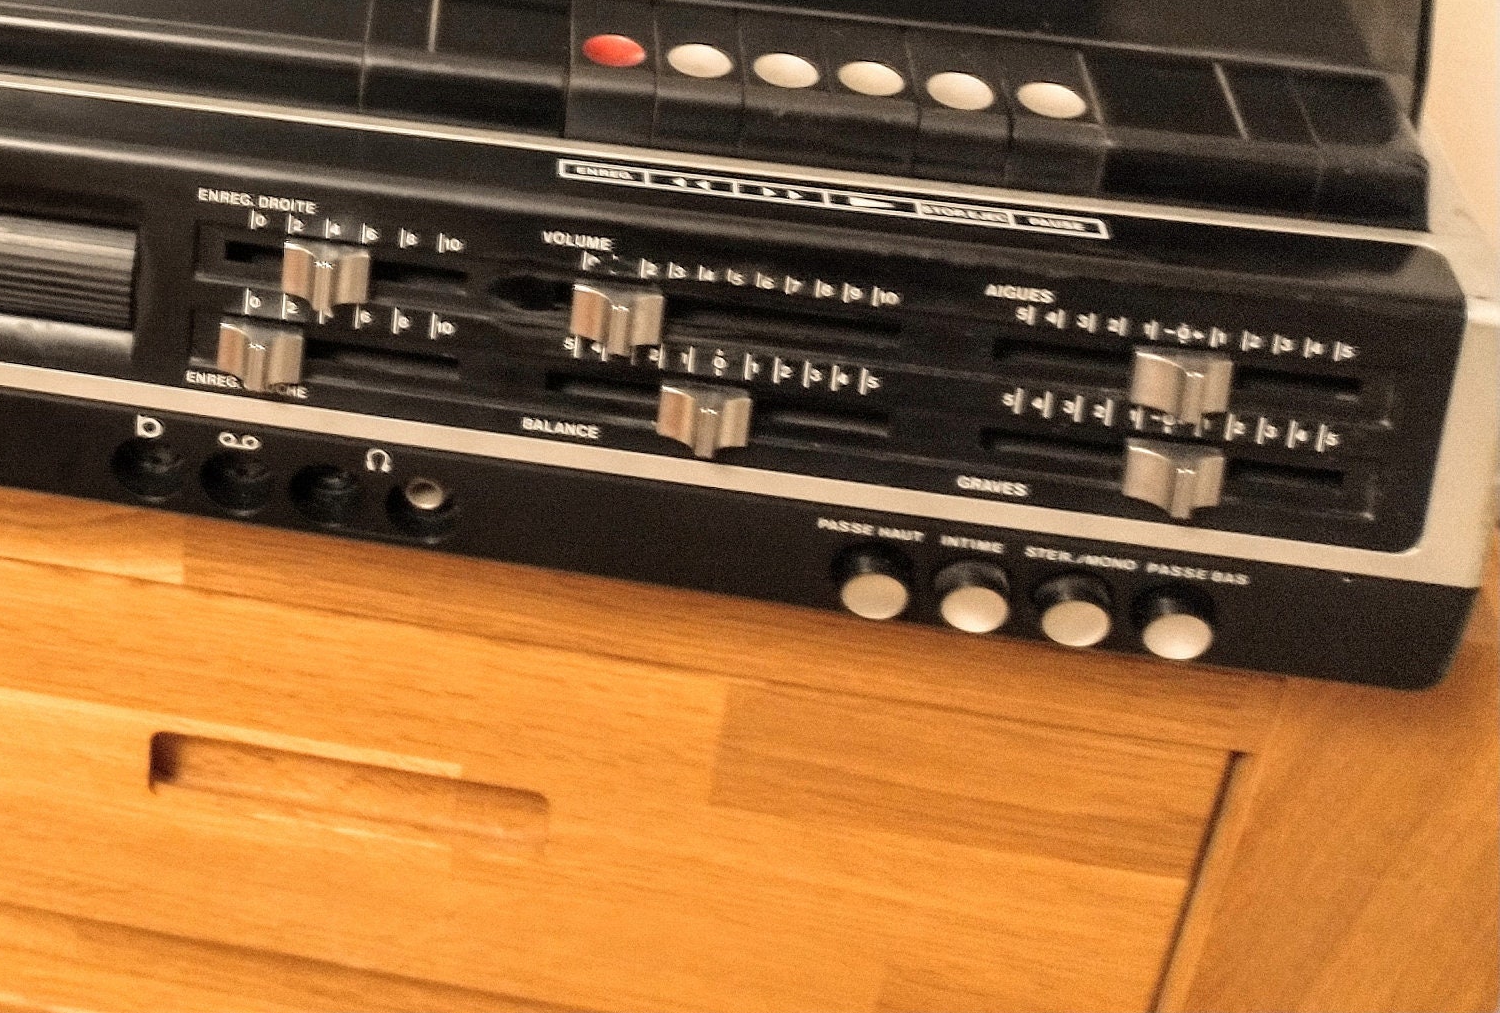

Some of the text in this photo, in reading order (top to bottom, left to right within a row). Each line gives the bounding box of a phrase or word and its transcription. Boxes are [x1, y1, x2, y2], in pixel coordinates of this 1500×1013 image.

[198, 187, 318, 215] ENREG. DROITE
[443, 237, 464, 251] 10
[542, 230, 613, 251] VOLUME
[984, 284, 1055, 304] AIGUES
[436, 319, 456, 336] 10
[522, 416, 600, 439] BALANCE
[956, 474, 1030, 497] GRAVES
[817, 517, 925, 543] PASSE HAUT
[1145, 561, 1252, 586] PASSE BAS
